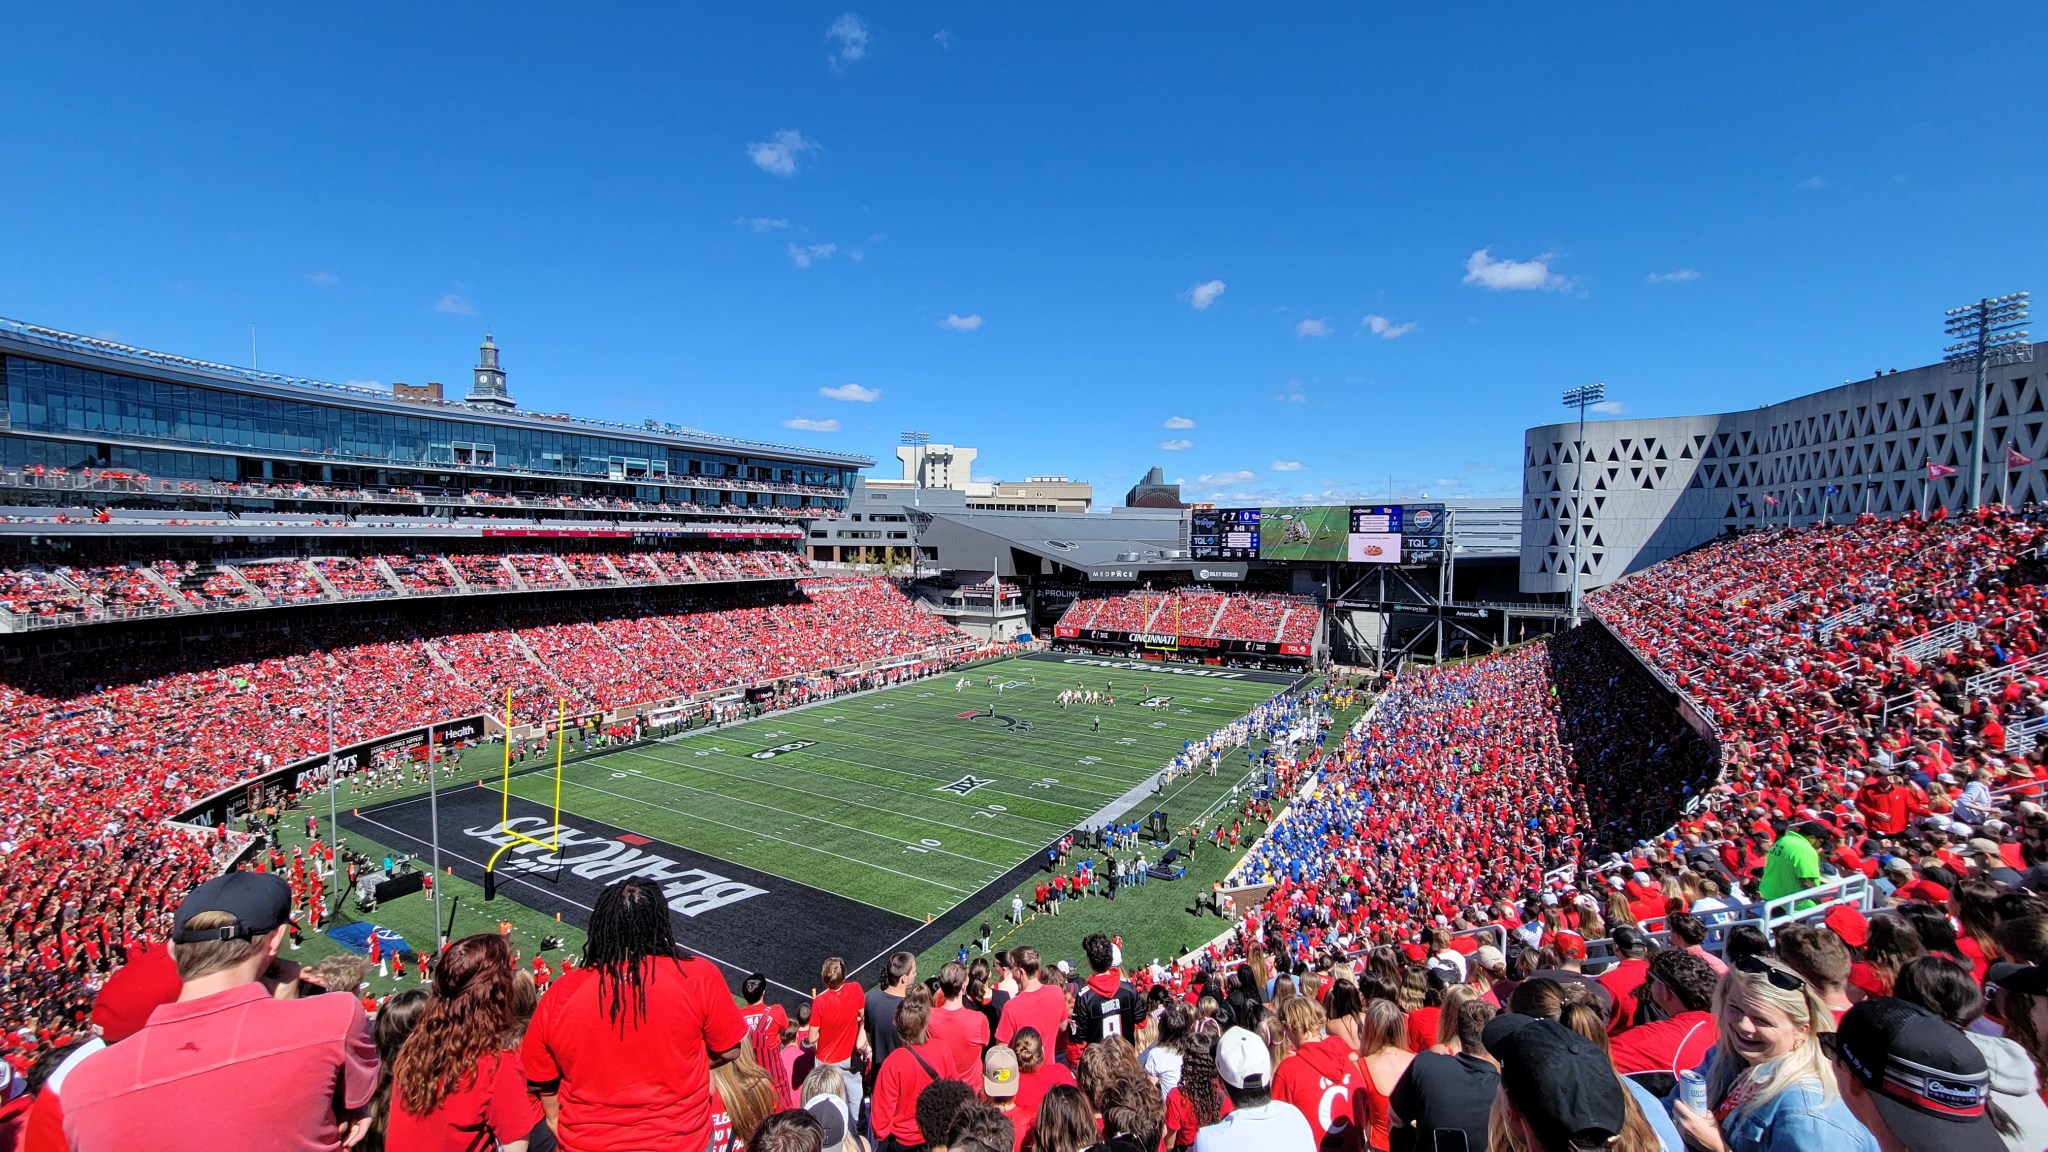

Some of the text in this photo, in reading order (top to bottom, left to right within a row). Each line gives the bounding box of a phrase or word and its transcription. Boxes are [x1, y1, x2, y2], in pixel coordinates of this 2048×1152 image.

[1230, 512, 1236, 520] 7
[1244, 512, 1249, 520] 0
[1194, 537, 1207, 545] TQL
[1408, 539, 1427, 548] TQL
[1092, 569, 1133, 578] MEDPACE
[1128, 633, 1220, 648] CINCINNATI BEARCATS
[556, 720, 574, 728] TYOTA
[445, 726, 475, 740] Health
[1031, 778, 1060, 789] 30
[975, 804, 1008, 819] 20
[904, 838, 942, 854] 10
[463, 816, 770, 918] BEARCATS
